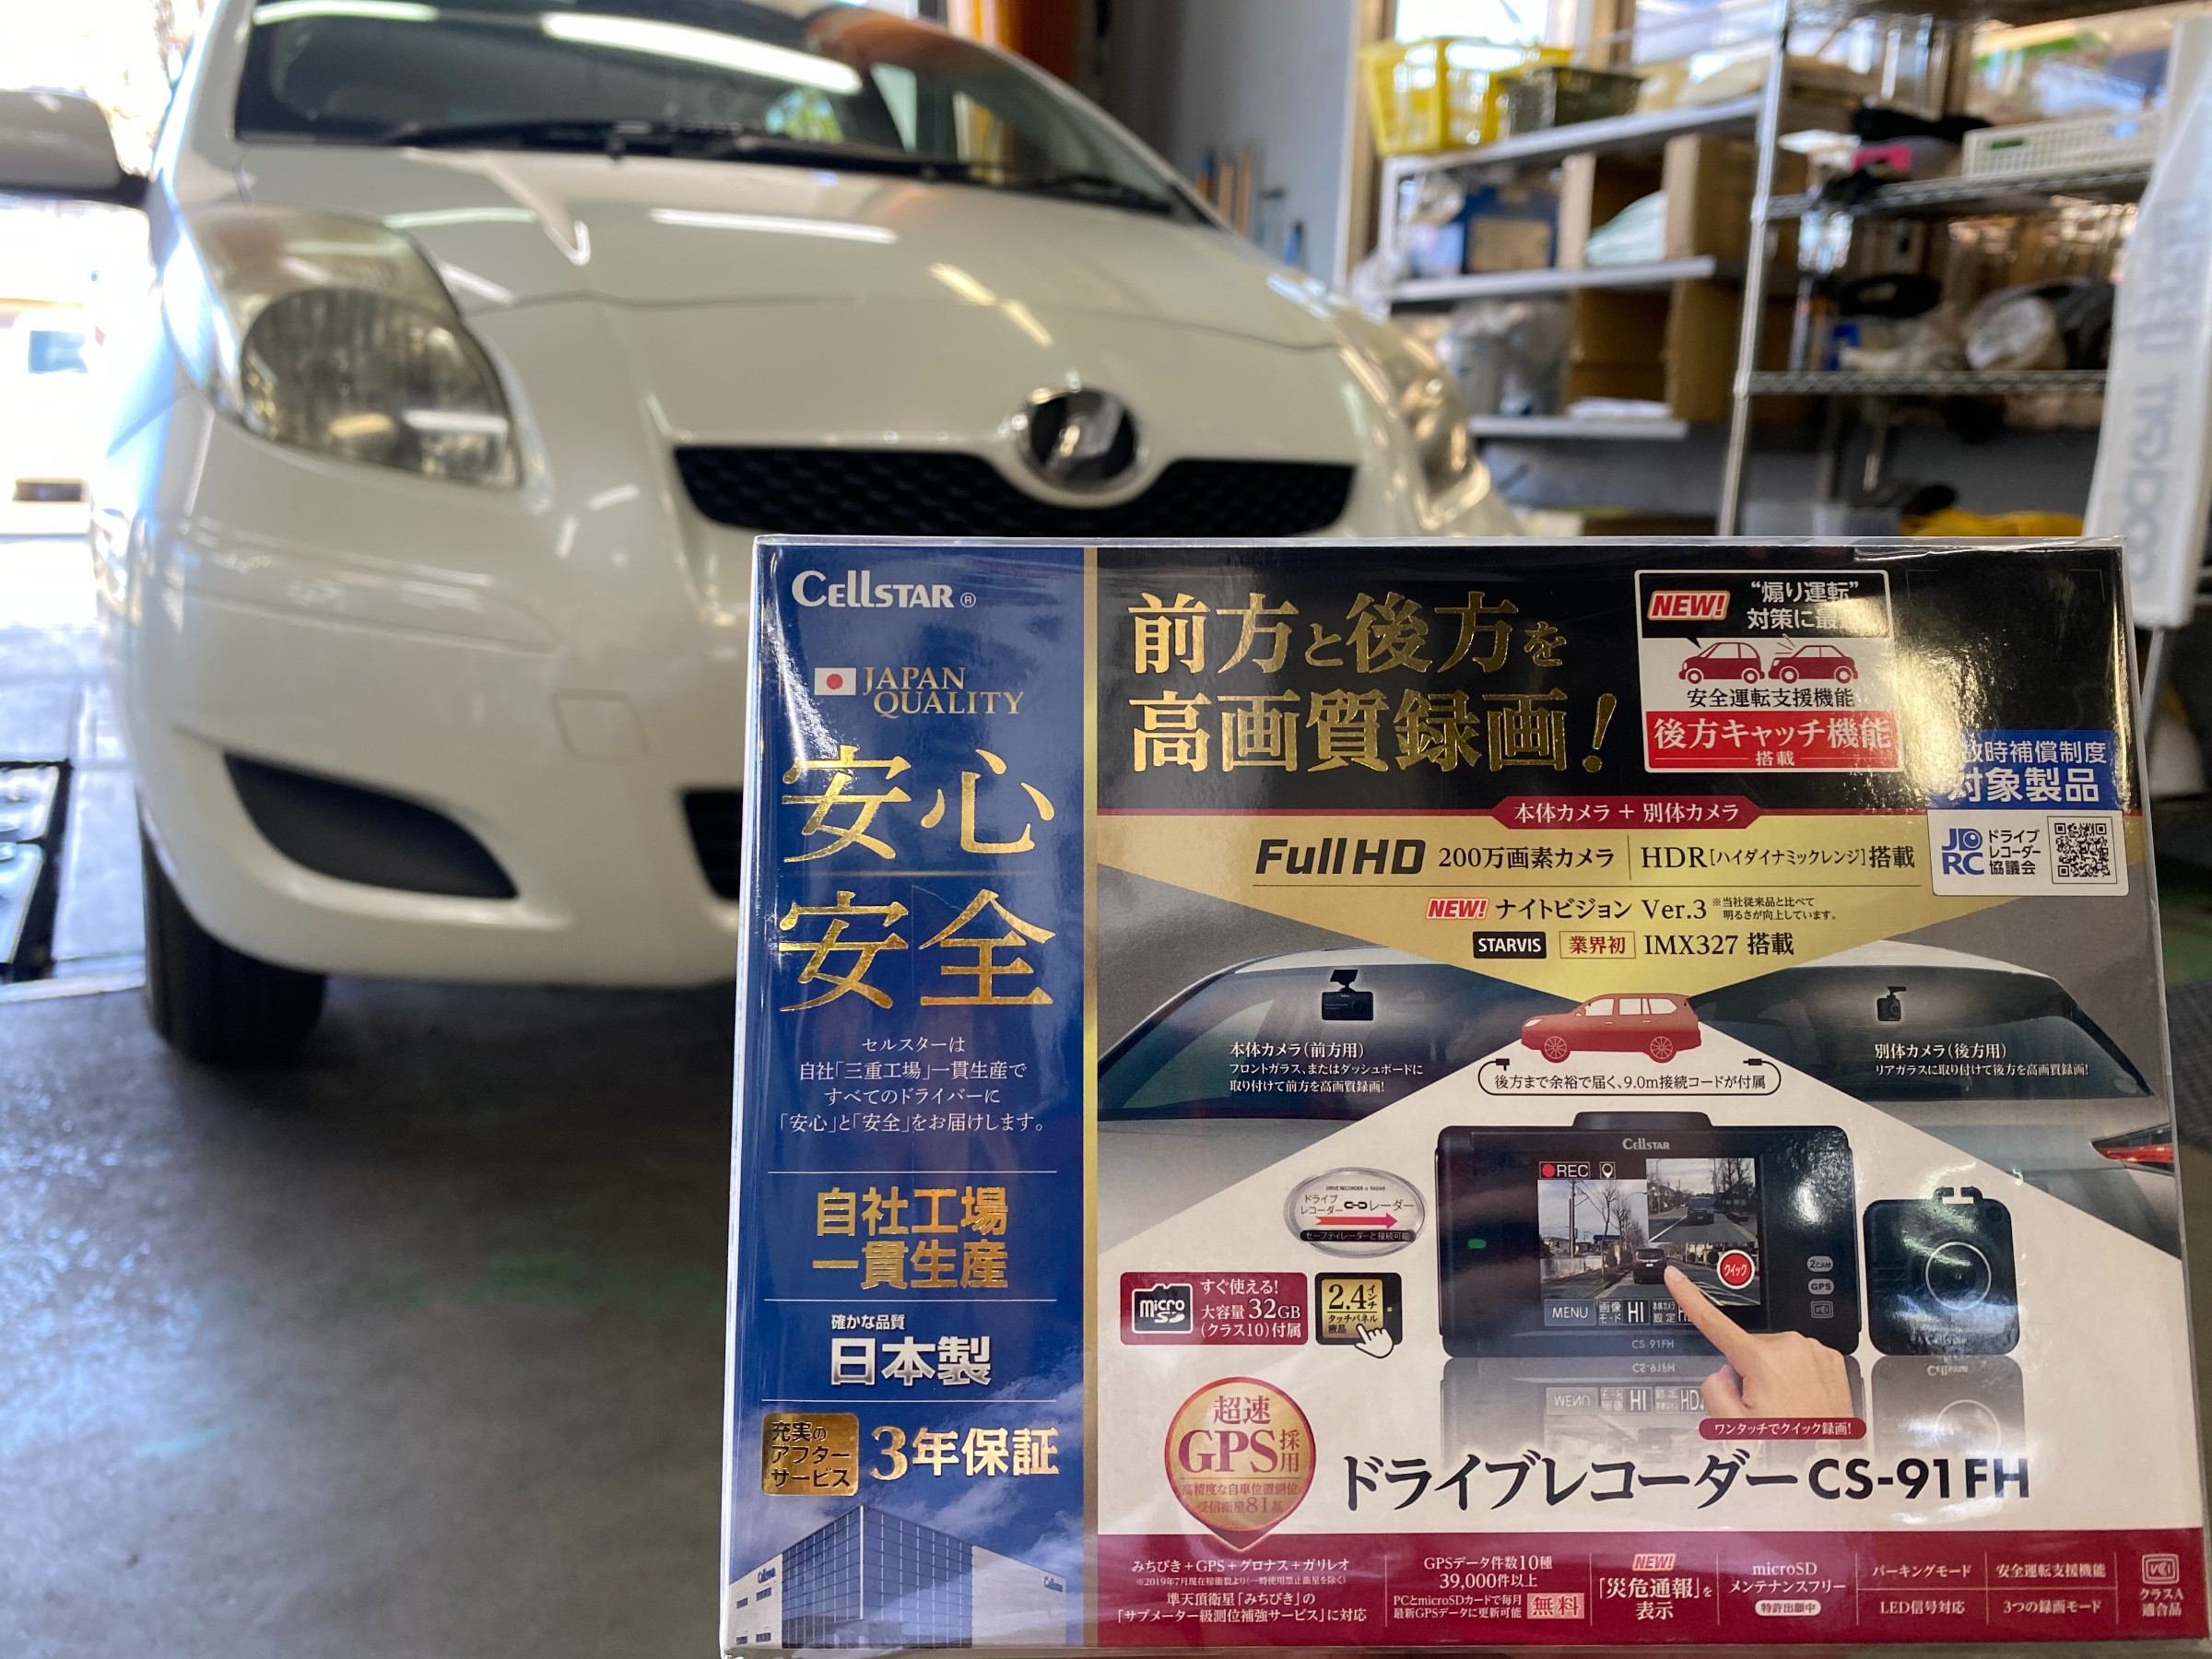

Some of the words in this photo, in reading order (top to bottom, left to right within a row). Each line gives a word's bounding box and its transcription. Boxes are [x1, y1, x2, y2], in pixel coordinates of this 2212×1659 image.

[1652, 594, 1724, 617] NEW!
[1747, 607, 1861, 629] 対策に最
[1127, 591, 1568, 675] 前方と後方を
[863, 666, 966, 695] JAPAN
[873, 691, 1024, 719] QUALITY
[1687, 688, 1855, 708] 安全運転支援機能
[1128, 688, 1618, 772] 高画質録画！
[1653, 717, 1890, 749] 後方キャッチ機能
[1756, 750, 1795, 767] 搭載
[1947, 767, 2100, 803] 対象製品
[782, 745, 1055, 863] 安心
[1989, 830, 2040, 844] ドライブ
[1439, 846, 1615, 870] 200万画素カメラ
[1989, 845, 2041, 859] レコーダー
[1989, 860, 2036, 876] 協議会
[1429, 900, 1487, 918] NEW!
[1496, 899, 1632, 920] ナイトビジョン
[1641, 899, 1707, 920] Ver.3
[1724, 910, 1837, 921] 明るさが向上しています。
[779, 888, 1056, 1012] 安全
[1477, 937, 1542, 953] STARVIS
[1569, 935, 1626, 955] 業界初
[1644, 935, 1738, 955] IMX327
[1747, 932, 1794, 956] 搭載
[861, 1036, 966, 1053] セルスターは
[799, 1060, 1028, 1081] 自社「三重工場」一貫生産で
[824, 1087, 1001, 1106] すべてのドライバーに
[779, 1112, 1043, 1133] 「安心」と「安全」をお届けします。
[1557, 1165, 1589, 1177] REC
[1305, 1194, 1338, 1204] ドライブ
[1370, 1199, 1415, 1211] レーダー
[817, 1185, 1009, 1237] 自社工場
[1300, 1206, 1343, 1215] レコーダー
[812, 1239, 1008, 1289] 一貫生産
[1724, 1264, 1747, 1277] クイック
[1201, 1278, 1278, 1295] すぐ使える!
[1328, 1314, 1378, 1323] タッチパネル
[1552, 1307, 1588, 1318] MENU
[1628, 1301, 1644, 1323] HI
[831, 1314, 905, 1331] 確かな品質
[830, 1335, 993, 1386] 日本製
[1213, 1395, 1271, 1425] 超速
[771, 1421, 827, 1442] 充実の
[771, 1445, 851, 1465] アフター
[870, 1425, 1060, 1481] 3年保証
[1178, 1430, 1278, 1473] GPS
[1279, 1430, 1300, 1473] 採用
[771, 1468, 852, 1489] サービス
[1635, 1557, 1674, 1569] NEW!
[1752, 1561, 1818, 1575] microSD
[1872, 1564, 1971, 1579] パーキングモード
[1996, 1563, 2106, 1579] 安全運転支援機能
[1440, 1573, 1537, 1590] 39,000件以上
[1729, 1579, 1846, 1594] メンテナンスフリー
[2140, 1588, 2183, 1600] クラスA
[1394, 1607, 1522, 1618] 最新GPSデータに更新可能
[1532, 1596, 1579, 1617] 無料
[1636, 1601, 1674, 1619] 表示
[1880, 1600, 1965, 1615] LED信号対応
[2003, 1600, 2102, 1614] 3つの録画モード
